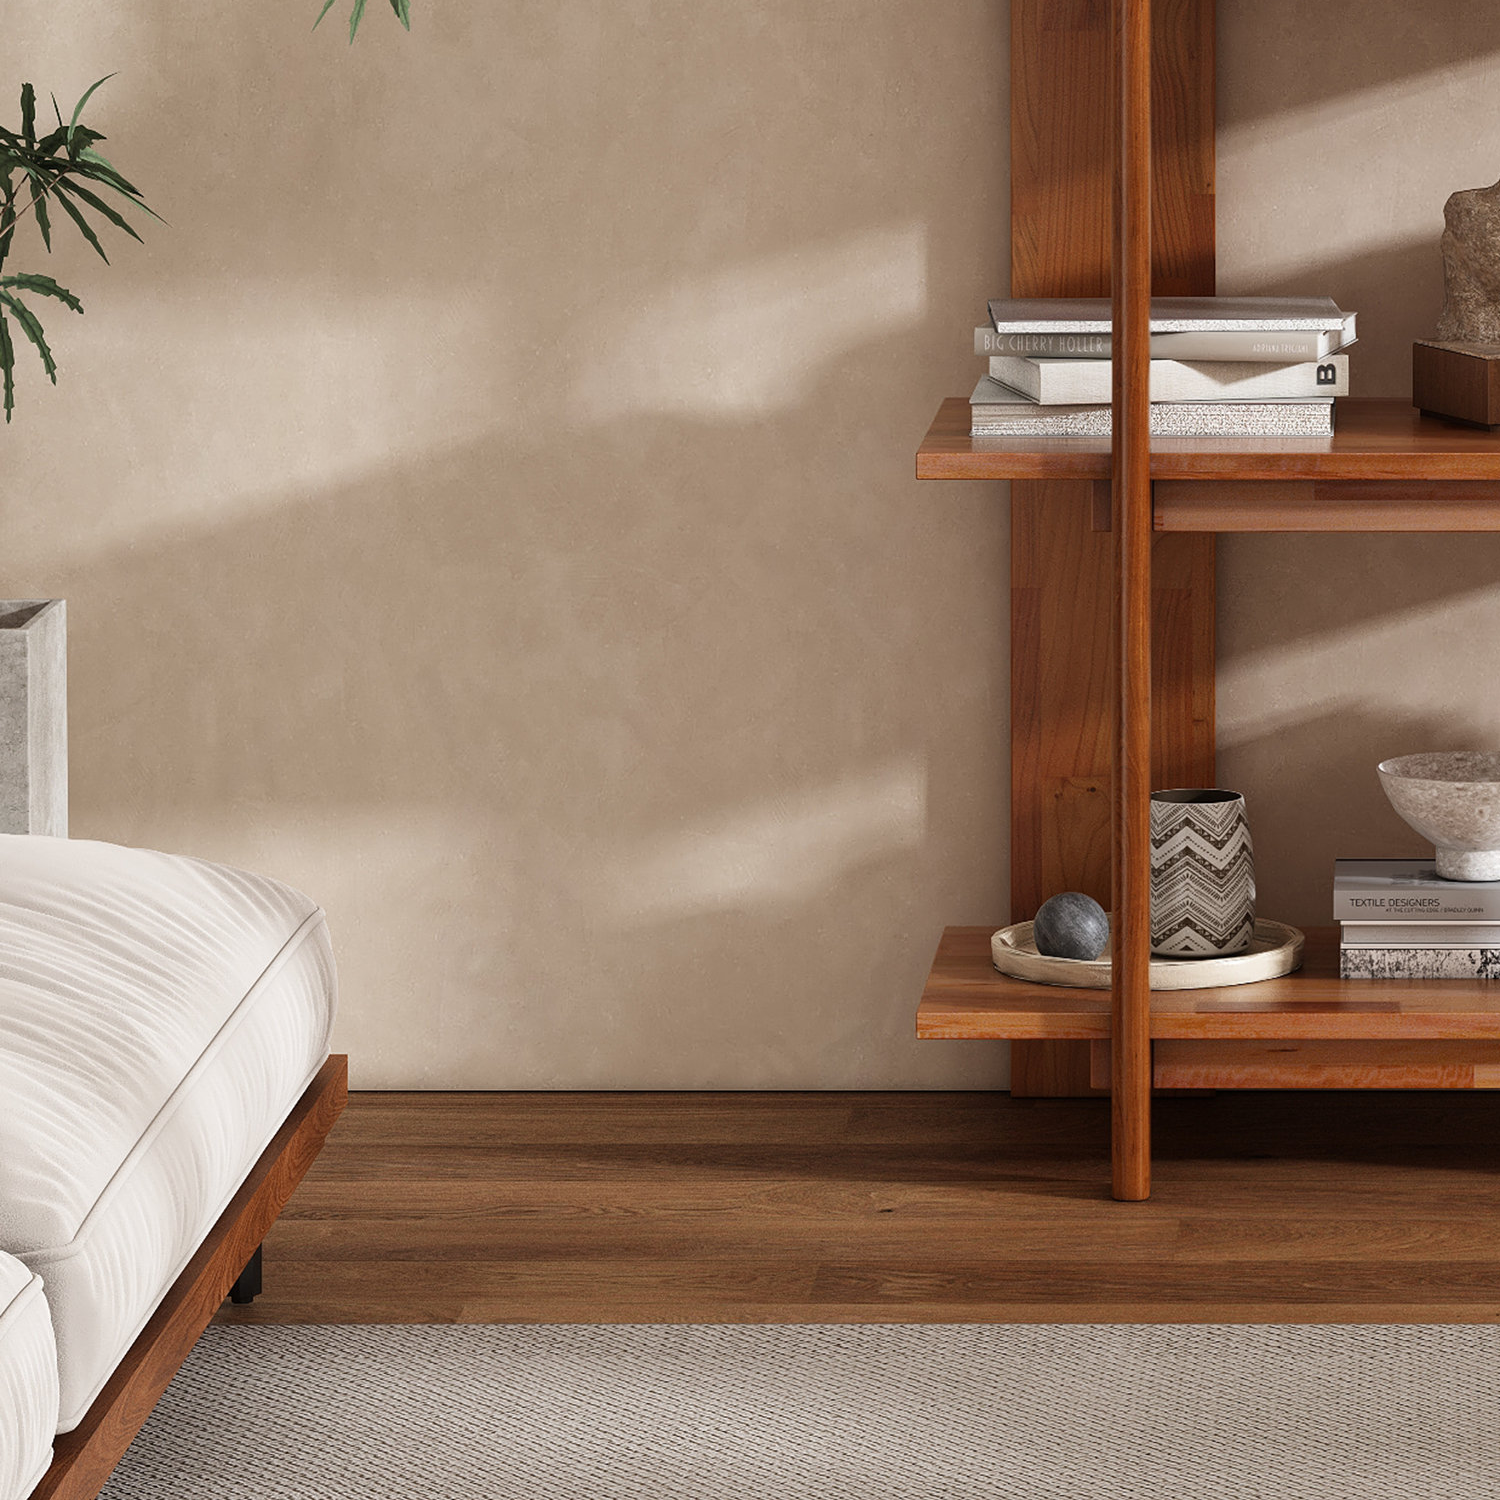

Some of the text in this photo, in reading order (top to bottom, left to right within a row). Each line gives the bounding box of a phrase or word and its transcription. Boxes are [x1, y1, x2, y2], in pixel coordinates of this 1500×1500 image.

[984, 334, 1103, 352] BIG CHERRY HOLLER
[1316, 363, 1337, 385] B
[1350, 898, 1440, 907] TEXTILE DESIGNERS
